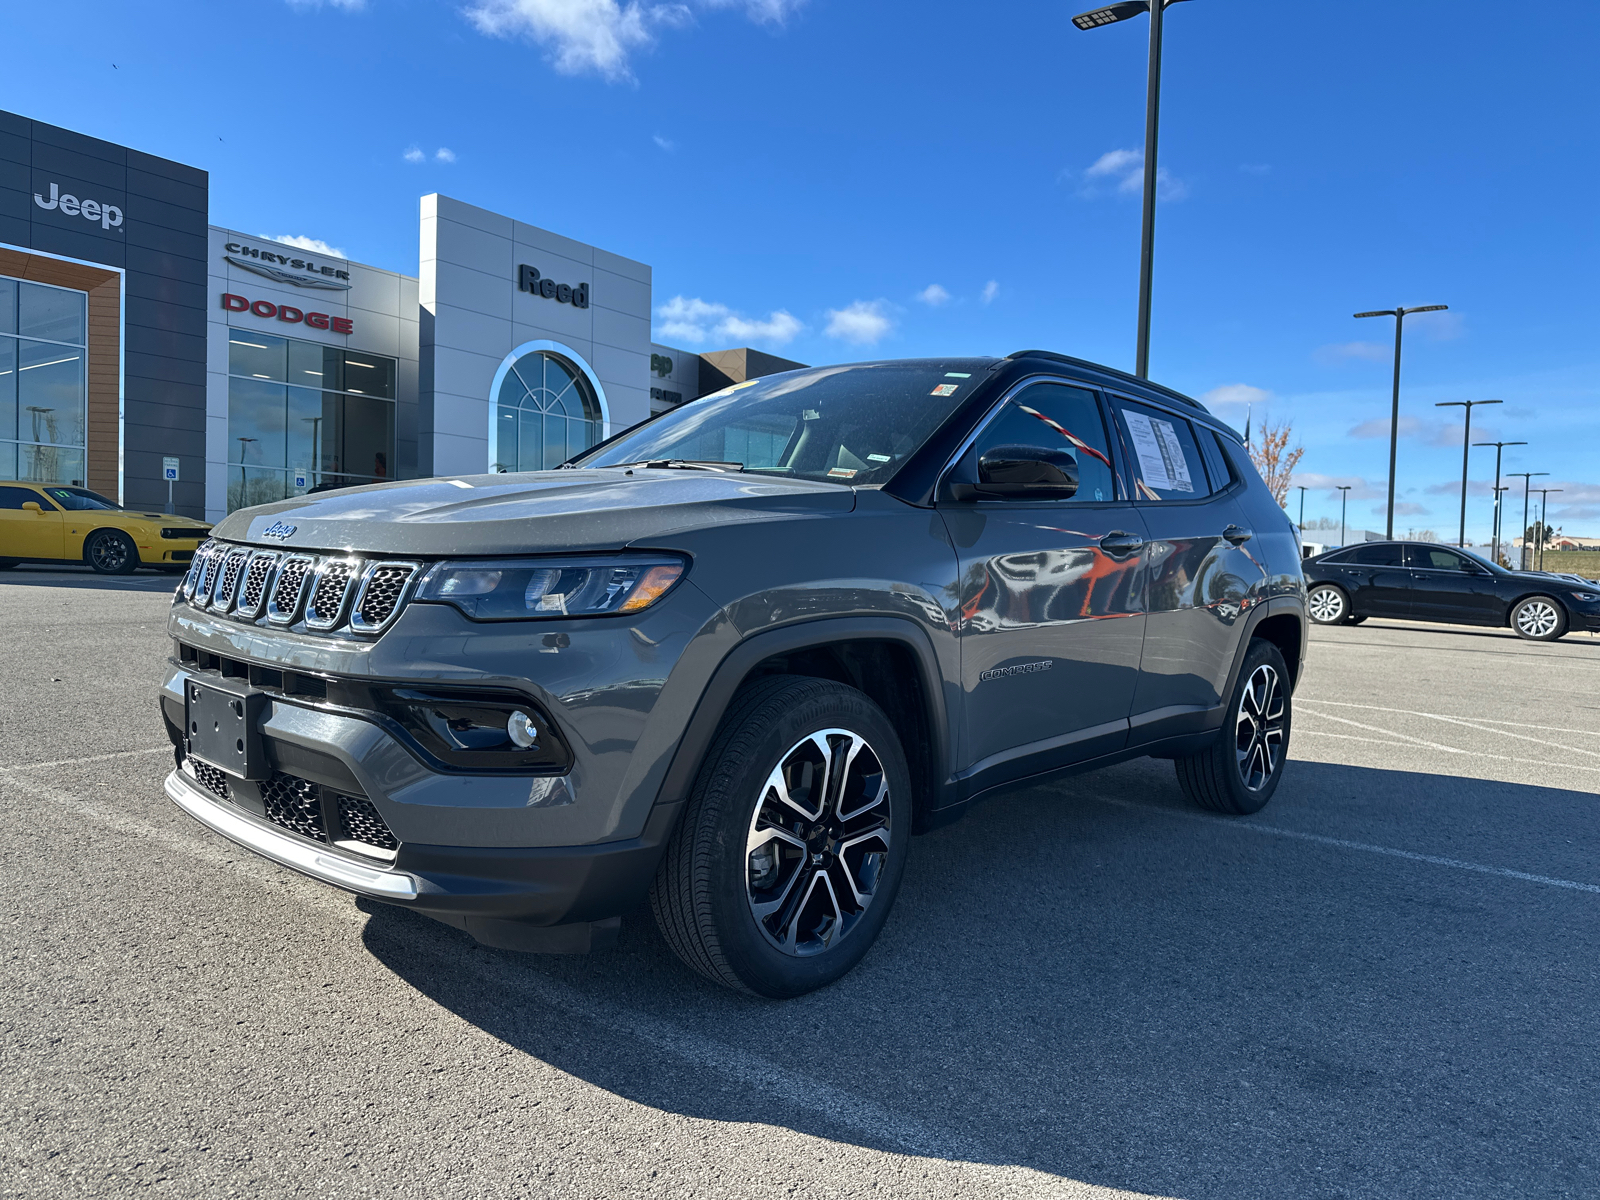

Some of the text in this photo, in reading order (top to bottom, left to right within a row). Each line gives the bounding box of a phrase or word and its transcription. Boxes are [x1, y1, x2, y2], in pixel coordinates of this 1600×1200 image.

[34, 182, 123, 230] Jeep
[225, 242, 350, 281] CHRYSLER
[518, 263, 589, 310] Reed
[221, 292, 353, 334] DODGE
[651, 353, 673, 377] ep
[650, 387, 682, 404] AM
[262, 520, 298, 541] Jeep
[979, 660, 1053, 682] COMPASS
